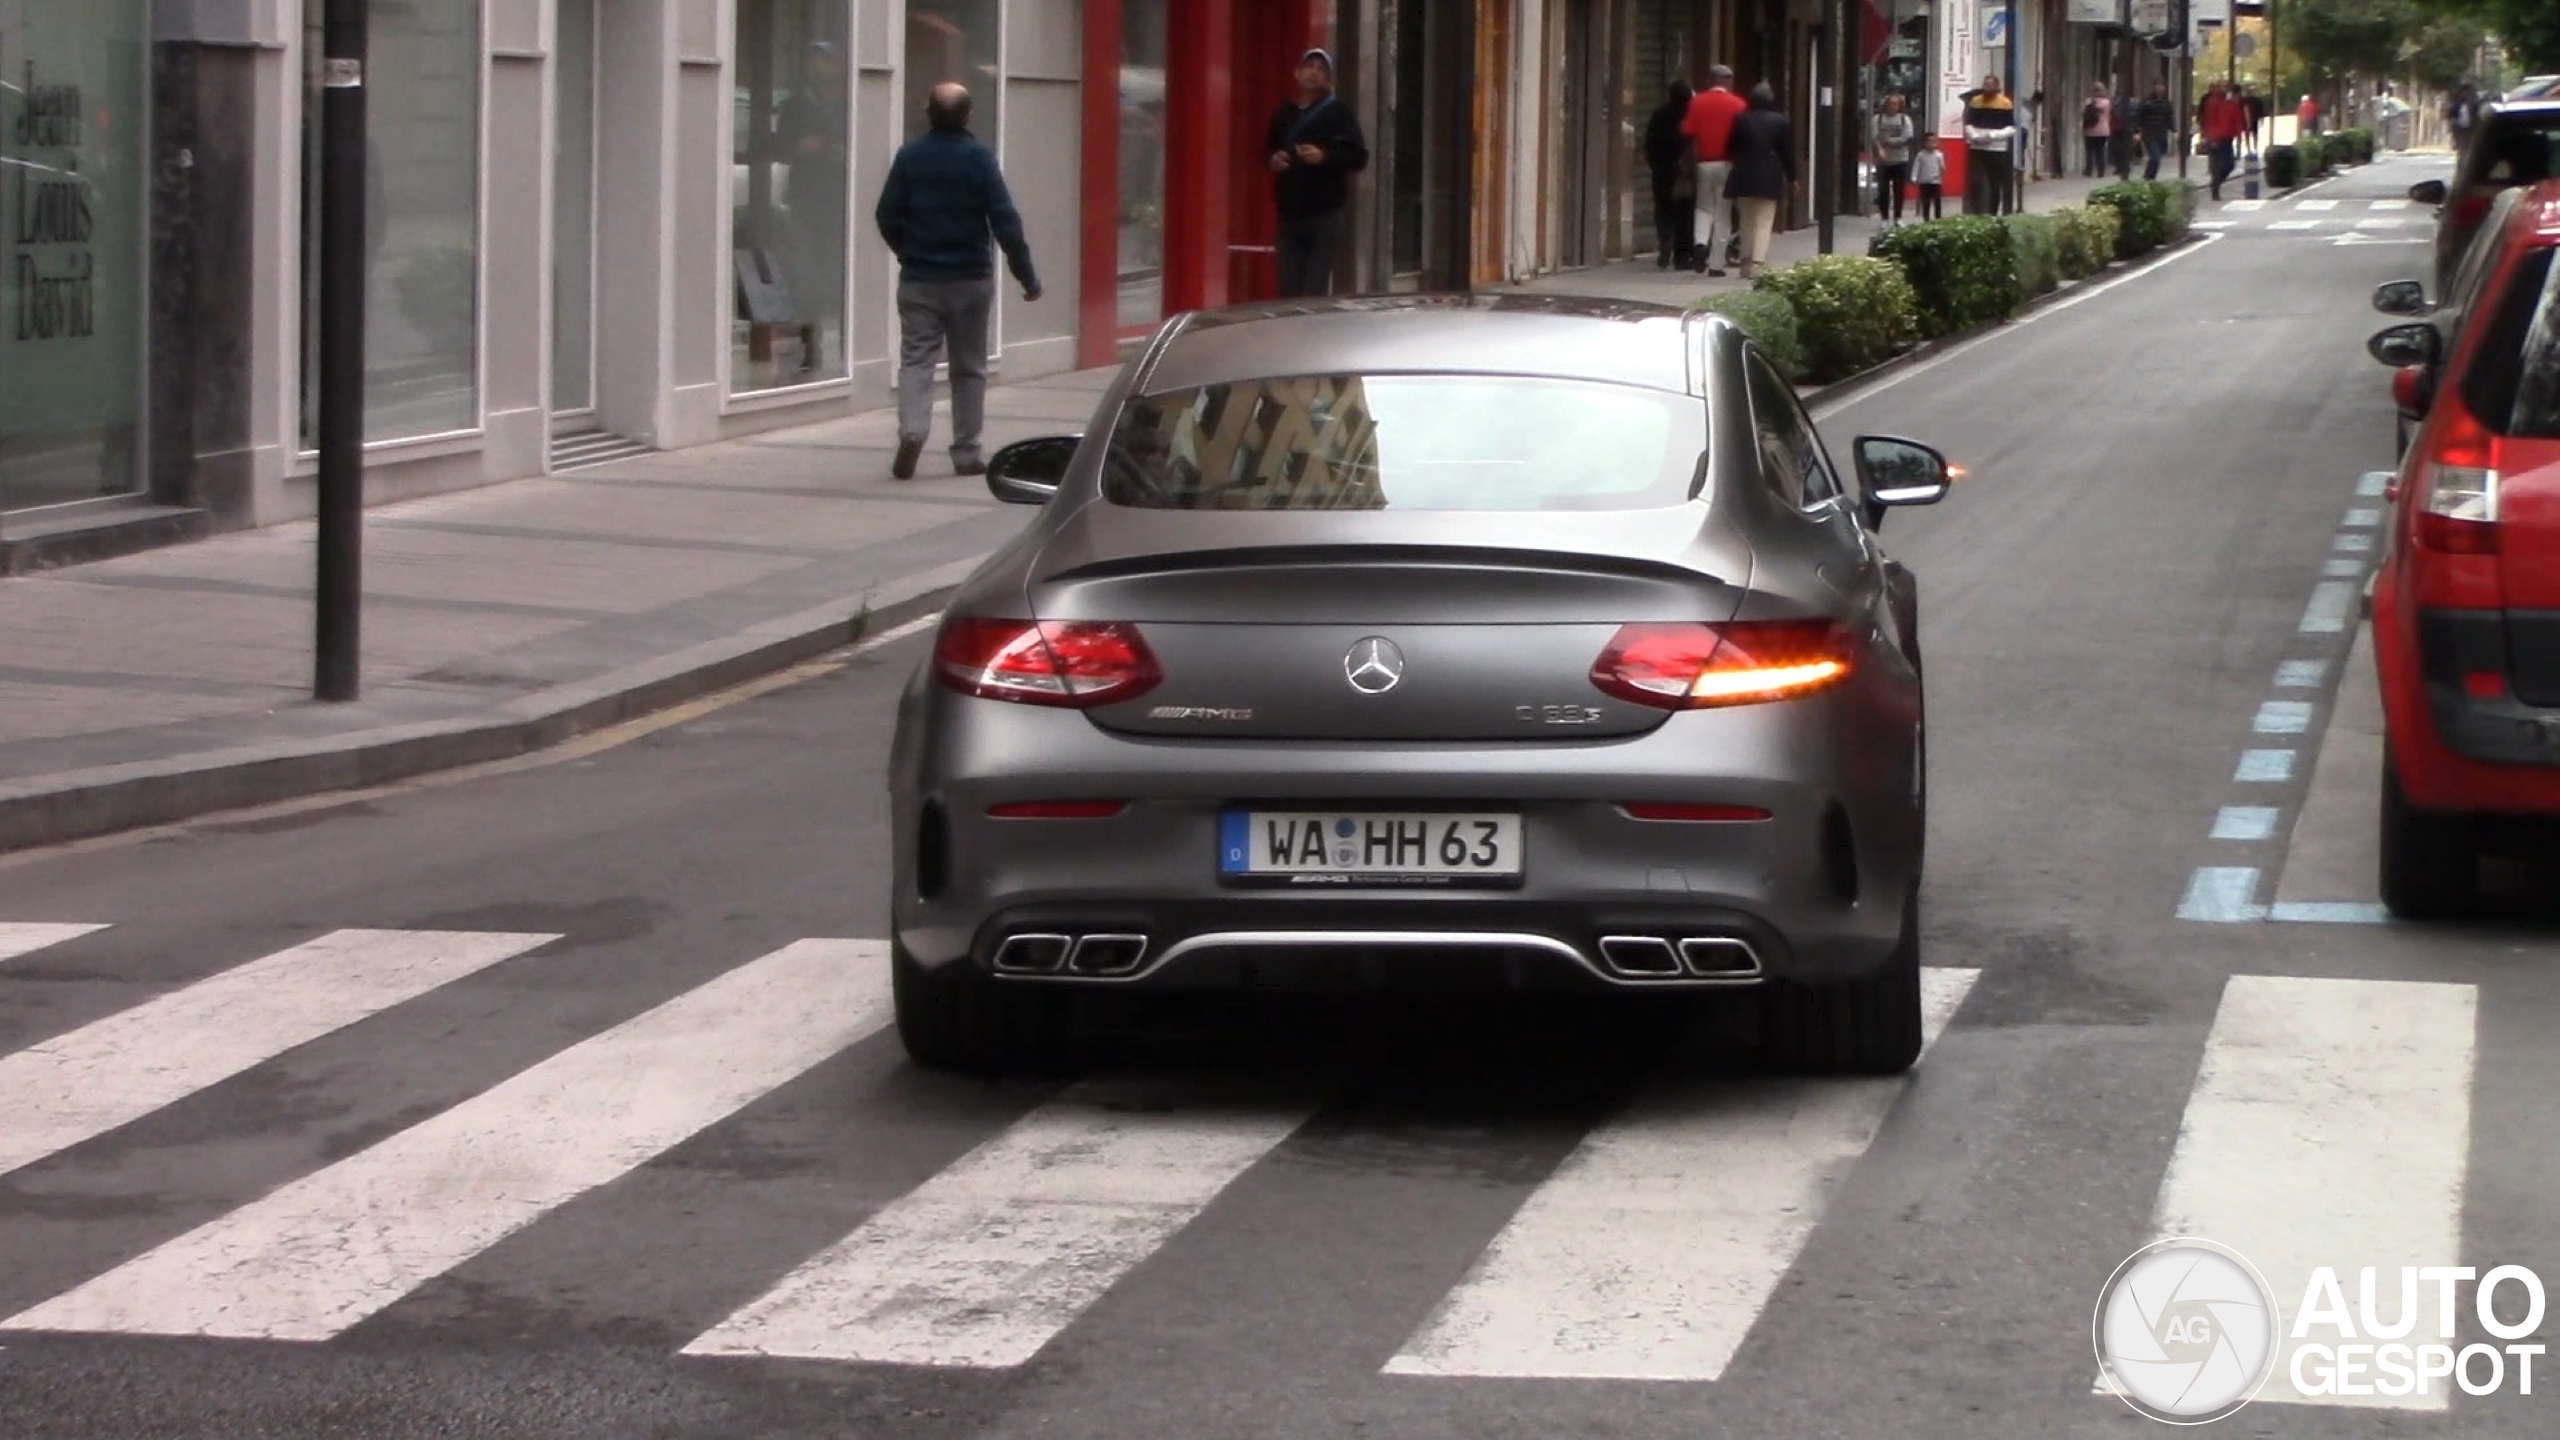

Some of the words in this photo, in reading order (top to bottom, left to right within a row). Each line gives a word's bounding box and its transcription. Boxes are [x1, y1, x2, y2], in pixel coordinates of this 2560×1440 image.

[17, 59, 82, 146] Jean
[16, 158, 93, 245] Louis
[17, 252, 94, 340] David
[1267, 820, 1328, 866] WA
[1364, 820, 1427, 866] HH
[1440, 820, 1499, 867] 63
